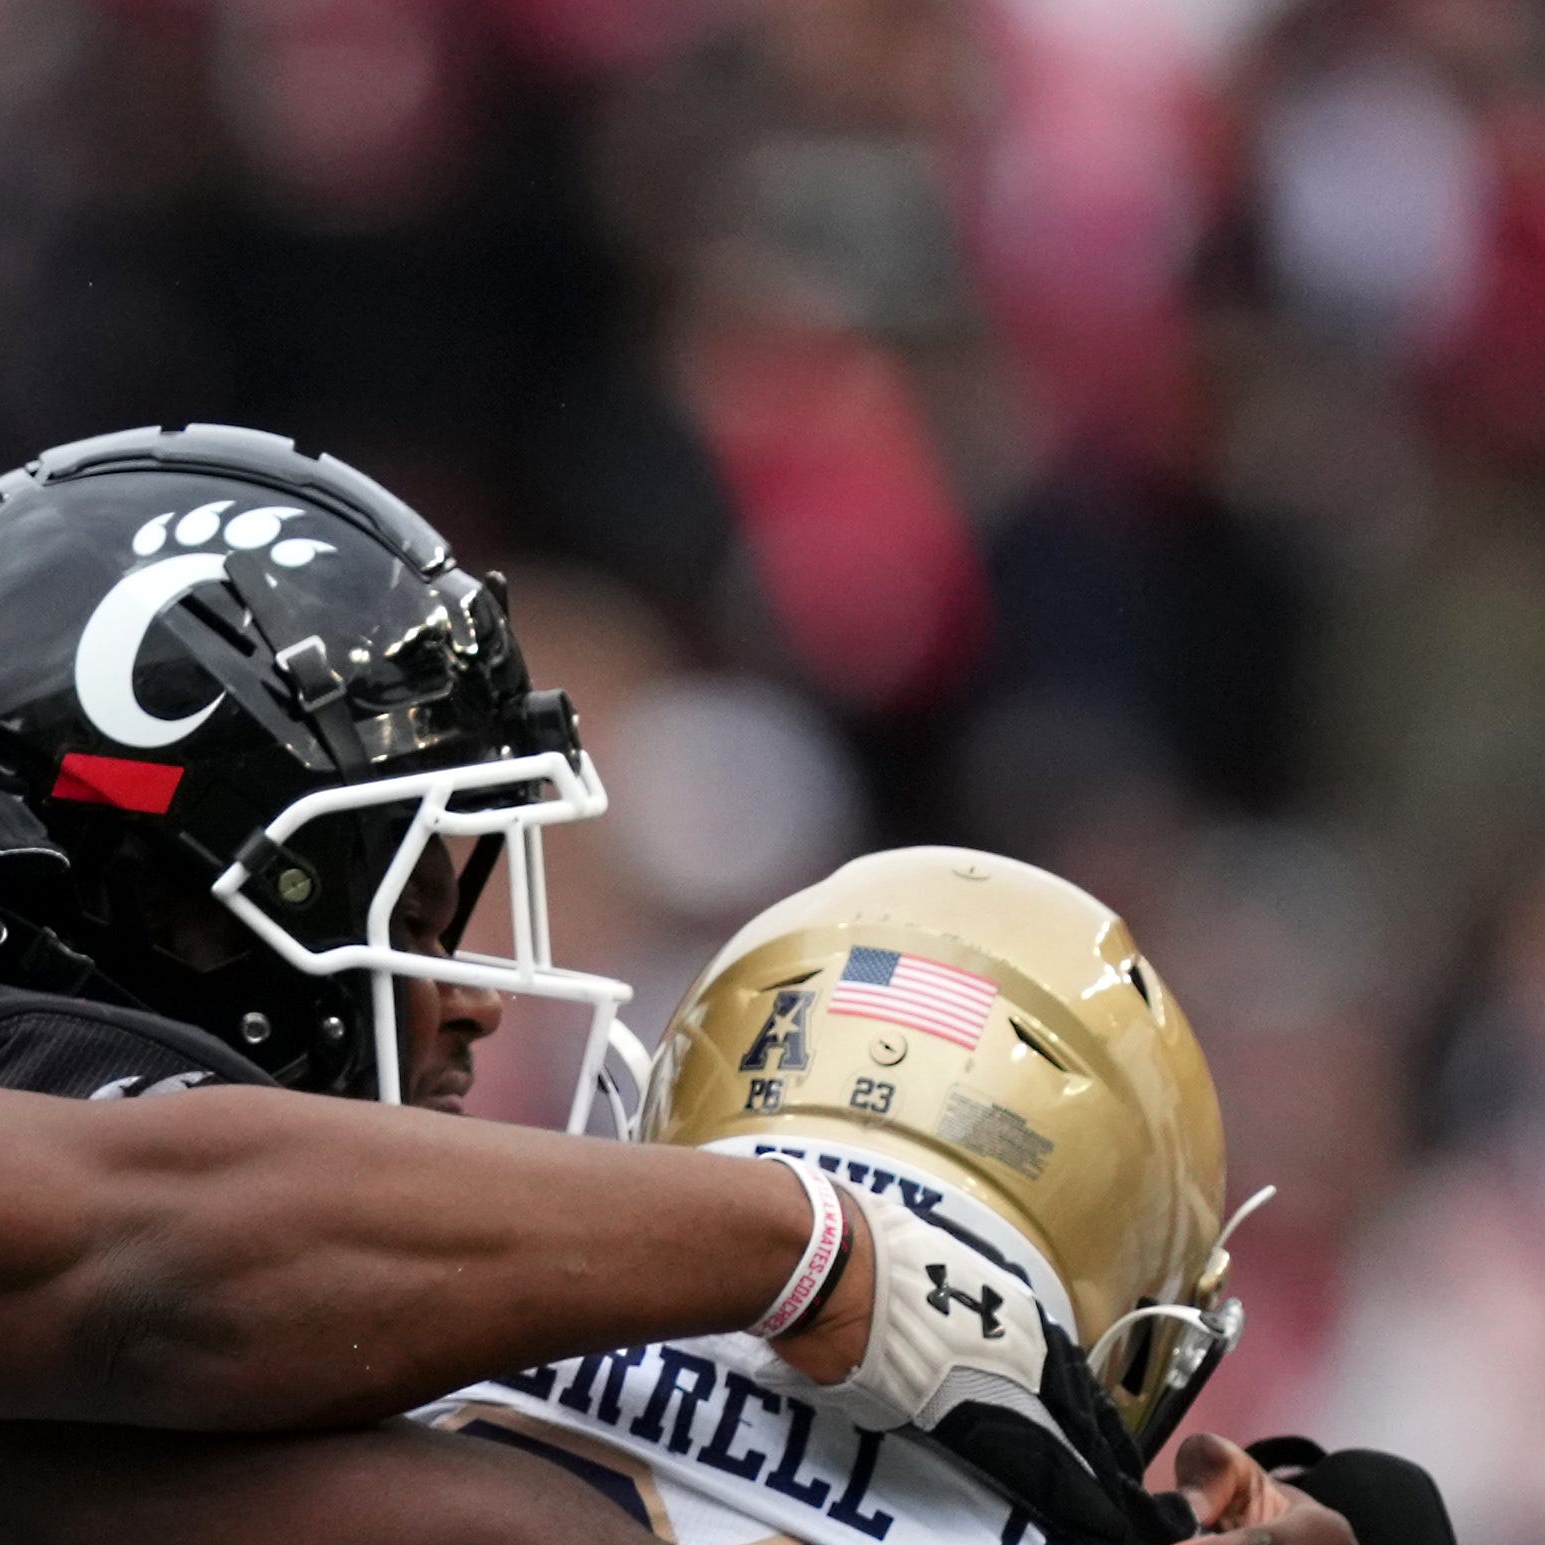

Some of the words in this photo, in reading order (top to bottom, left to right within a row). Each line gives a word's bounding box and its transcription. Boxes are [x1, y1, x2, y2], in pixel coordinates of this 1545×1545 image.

[738, 990, 817, 1073] A
[744, 1077, 785, 1112] P6
[849, 1076, 896, 1114] 23
